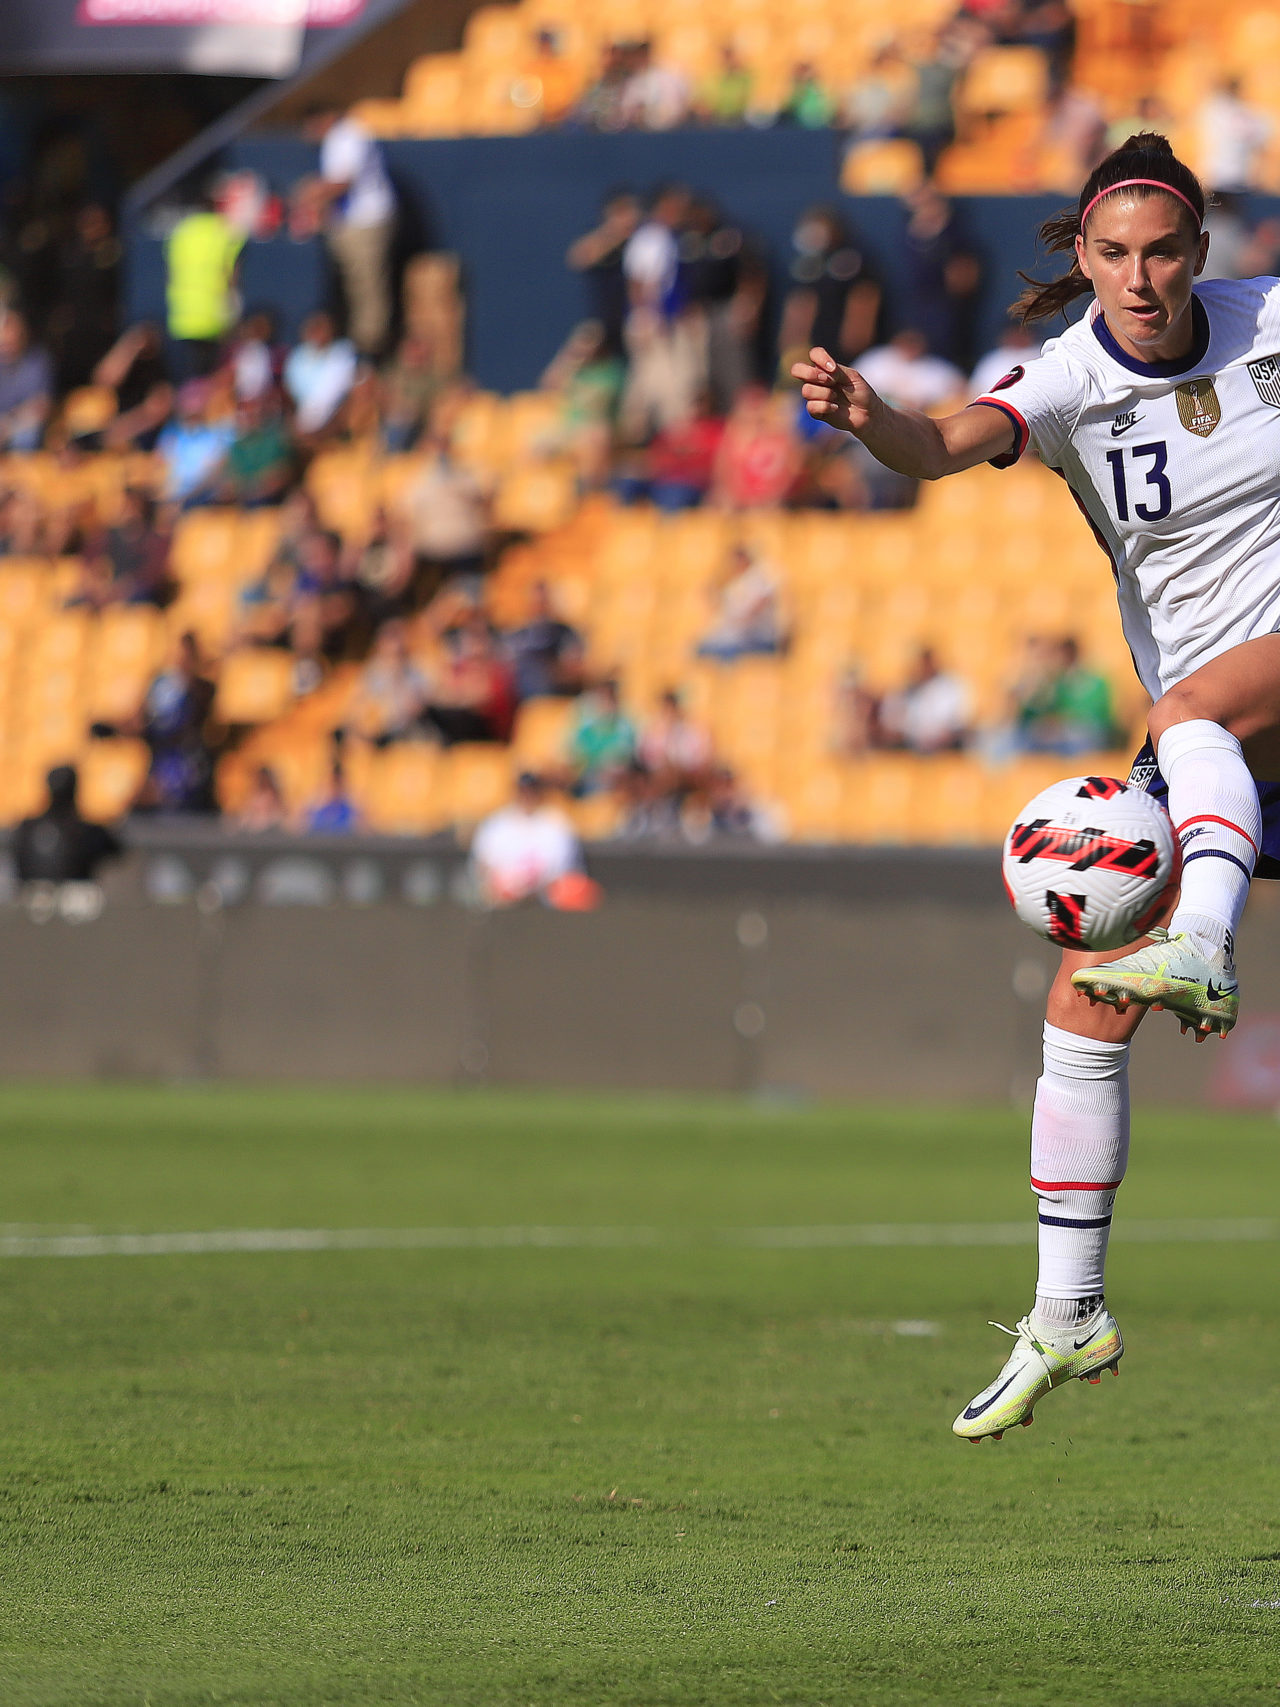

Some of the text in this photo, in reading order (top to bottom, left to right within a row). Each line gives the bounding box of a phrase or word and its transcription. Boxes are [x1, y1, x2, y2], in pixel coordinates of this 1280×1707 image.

[1251, 359, 1276, 380] USA
[1115, 411, 1136, 427] NIKE
[1192, 415, 1212, 425] FIFA
[1106, 440, 1171, 522] 13
[1131, 767, 1154, 782] USA
